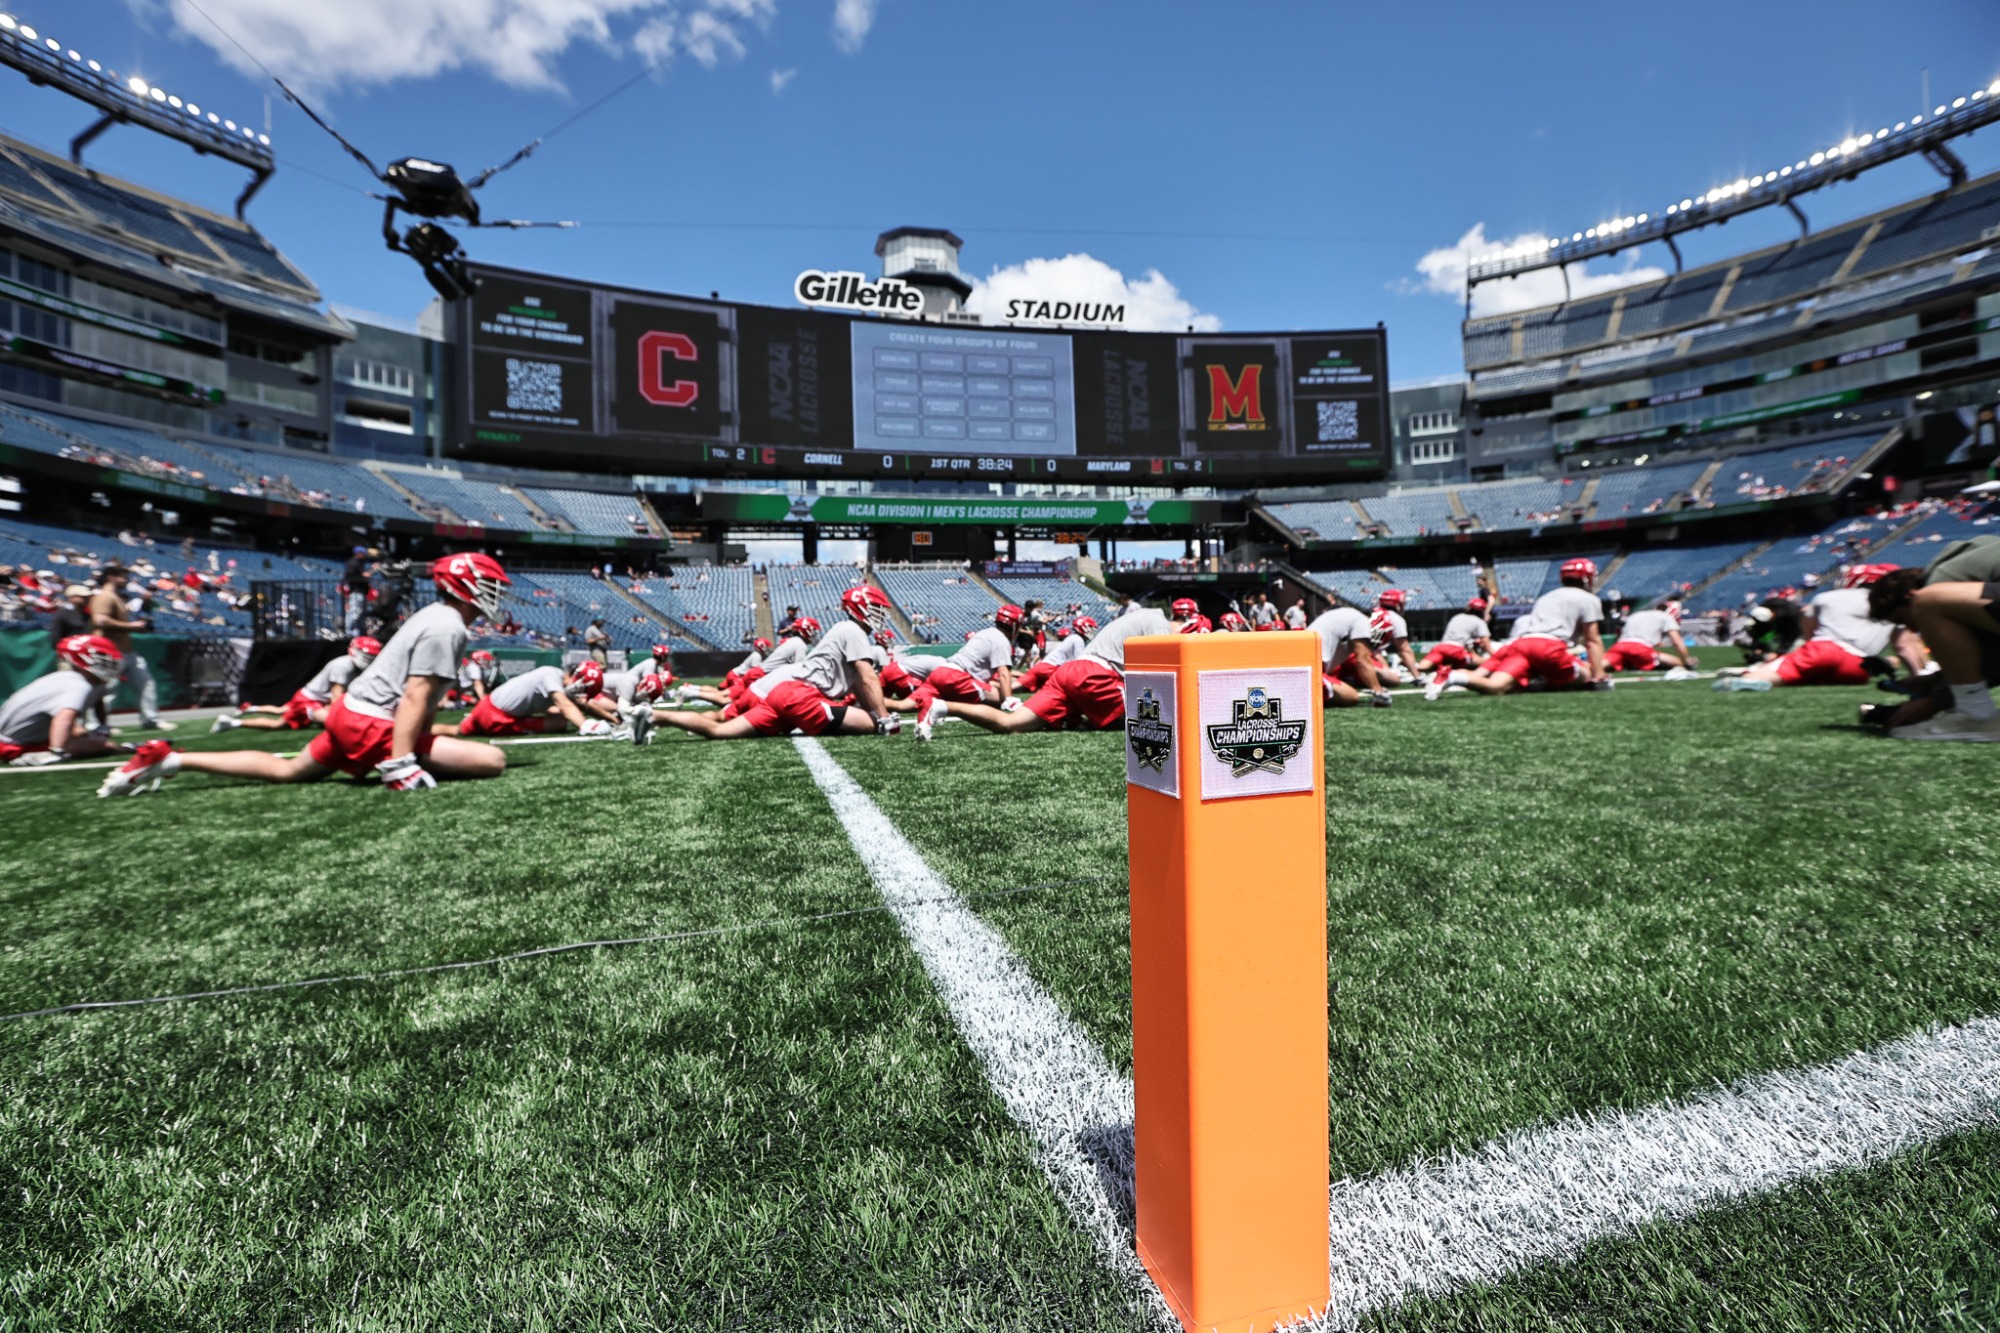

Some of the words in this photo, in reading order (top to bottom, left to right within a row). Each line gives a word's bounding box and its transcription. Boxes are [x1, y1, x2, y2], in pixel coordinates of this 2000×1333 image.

[799, 274, 921, 311] Gillette
[1005, 299, 1125, 323] STADIUM
[888, 332, 925, 344] CREATE
[928, 335, 954, 345] FOUR
[955, 337, 994, 348] GROUPS
[638, 330, 698, 407] C
[767, 341, 794, 422] NCAA
[796, 327, 819, 433] LACROSSE
[1103, 350, 1125, 447] LACROSSE
[1126, 359, 1151, 432] NCAA
[1206, 364, 1265, 423] M
[736, 449, 746, 460] 2
[804, 453, 843, 465] CORNELL
[930, 459, 949, 469] 1ST
[951, 459, 971, 469] QTR
[977, 458, 1013, 470] 38:24
[1087, 460, 1131, 471] MARYLAND
[1194, 460, 1203, 472] 2
[847, 504, 876, 517] NCAA
[878, 504, 925, 518] DIVISION
[926, 506, 932, 518] I
[933, 506, 966, 518] MEN'S
[967, 506, 1019, 519] LACROSSE
[1021, 506, 1098, 519] CHAMPIONSHIP
[449, 558, 466, 575] C
[1237, 718, 1279, 731] LACROSSE
[1216, 726, 1301, 744] CHAMPIONSHIPS
